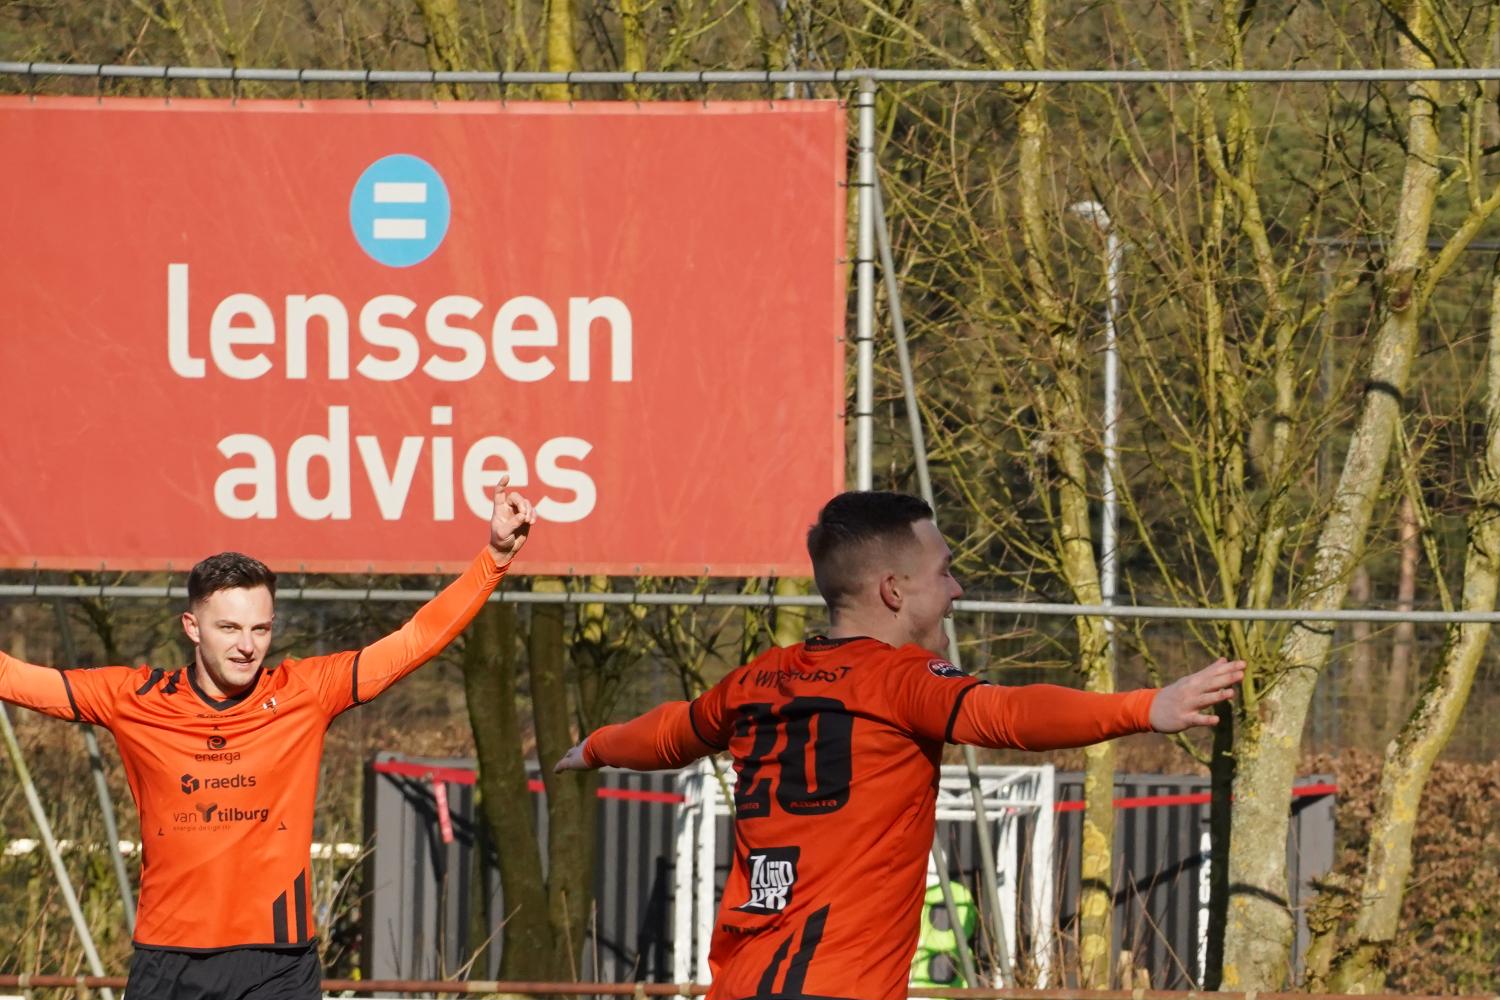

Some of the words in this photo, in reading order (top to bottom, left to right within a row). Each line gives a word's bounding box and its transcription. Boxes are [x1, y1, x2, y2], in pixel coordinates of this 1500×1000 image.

[168, 263, 632, 382] lenssen
[214, 405, 596, 521] advies
[173, 812, 197, 822] van
[218, 808, 269, 822] tilburg
[204, 774, 256, 789] raedts
[735, 696, 854, 819] 20
